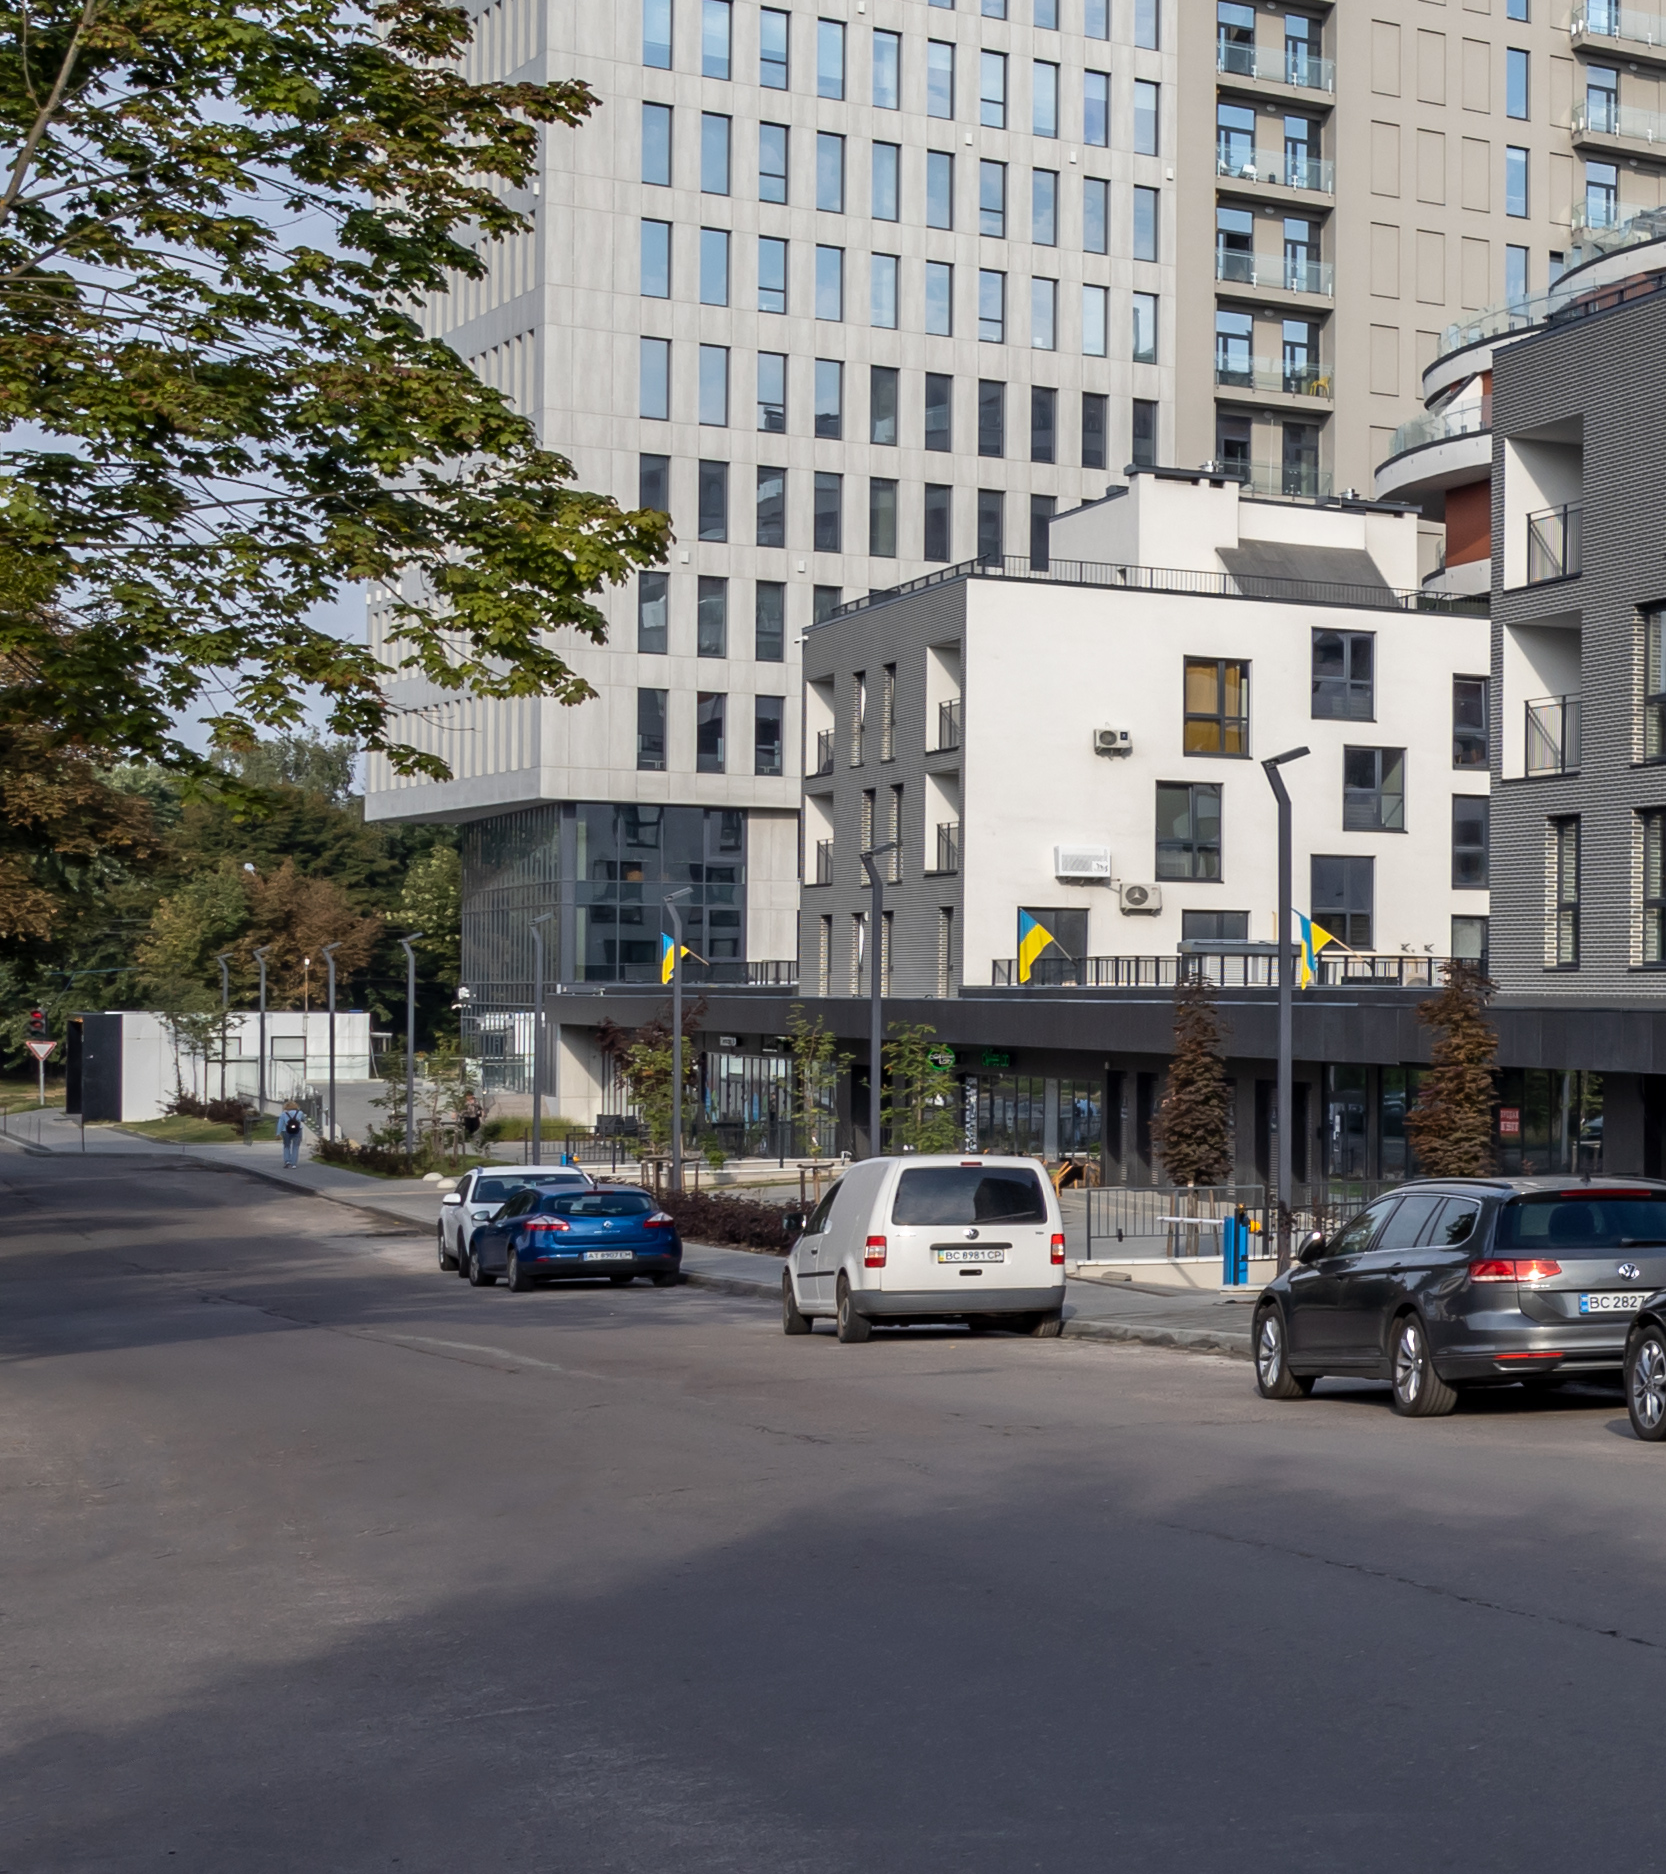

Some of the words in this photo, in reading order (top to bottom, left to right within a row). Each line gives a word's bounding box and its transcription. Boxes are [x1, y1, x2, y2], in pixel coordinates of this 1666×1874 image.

[945, 1251, 962, 1260] BC
[962, 1251, 986, 1259] 8981
[987, 1250, 1002, 1259] CP
[1589, 1296, 1610, 1309] BC
